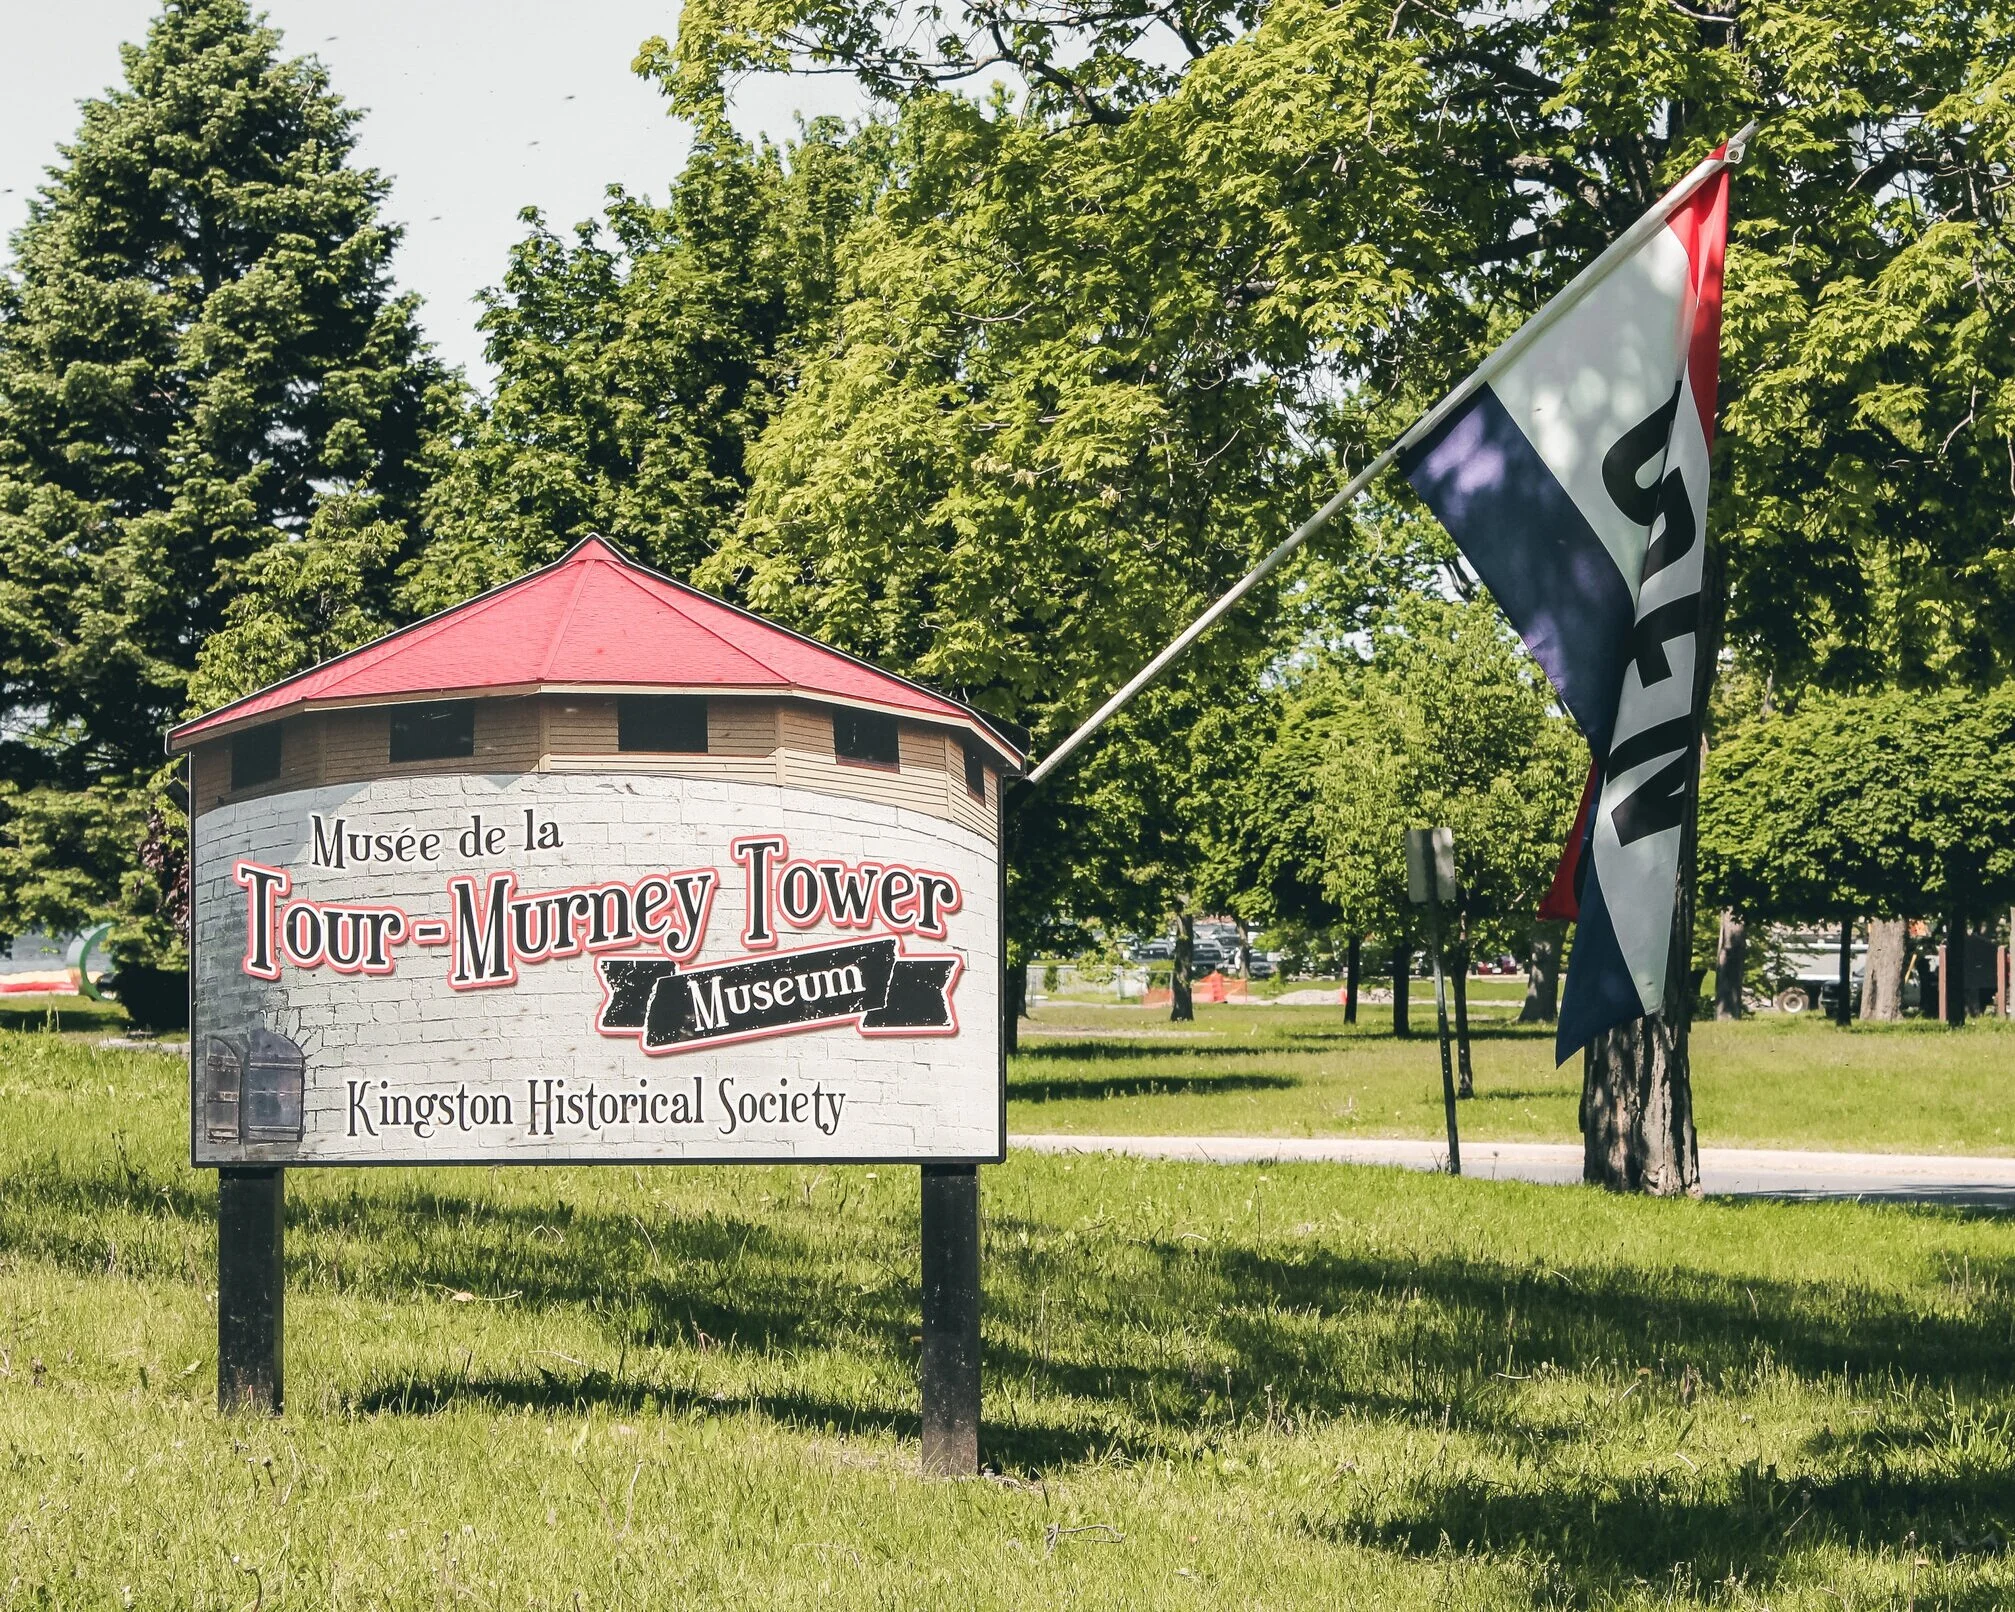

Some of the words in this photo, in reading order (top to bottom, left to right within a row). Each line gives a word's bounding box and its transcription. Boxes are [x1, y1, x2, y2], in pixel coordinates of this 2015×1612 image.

[311, 815, 440, 869] Musée
[458, 816, 506, 856] de
[523, 808, 564, 850] la
[736, 841, 955, 942] Tower
[690, 964, 866, 1031] Museum
[348, 1080, 513, 1137] Kingston
[528, 1078, 703, 1135] Historical
[718, 1078, 846, 1135] Society
